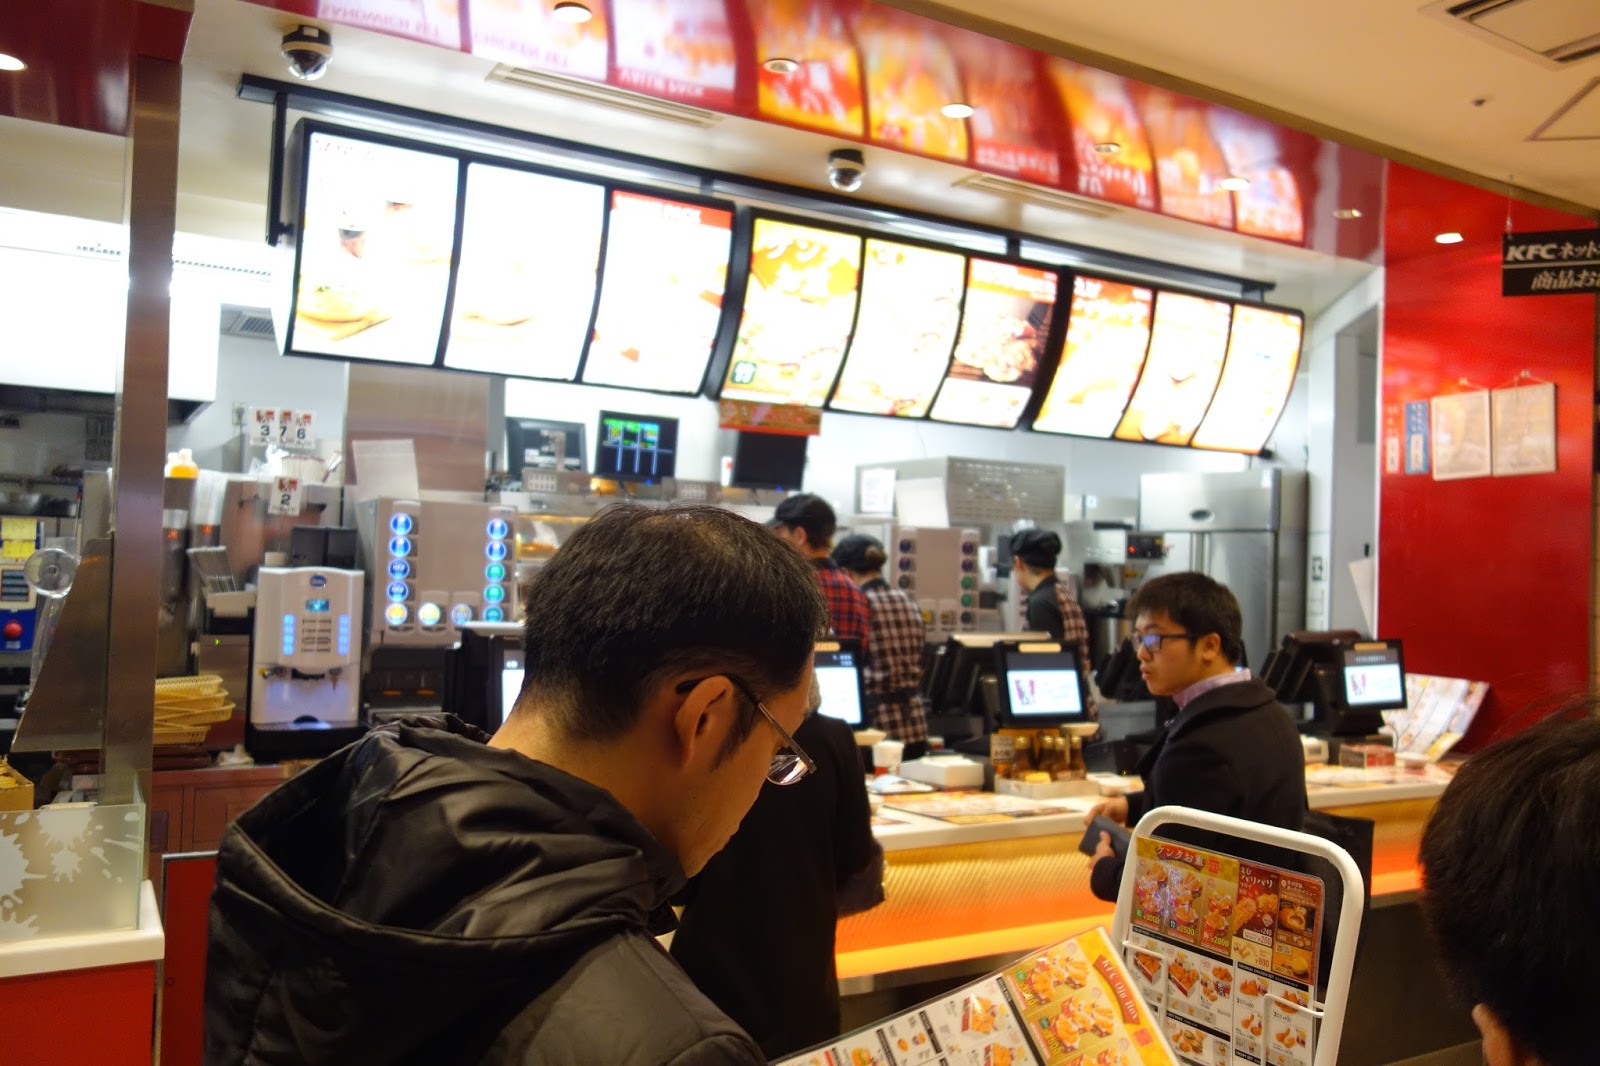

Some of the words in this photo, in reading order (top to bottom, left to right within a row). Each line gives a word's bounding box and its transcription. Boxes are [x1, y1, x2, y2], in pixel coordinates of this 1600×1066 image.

[1505, 243, 1557, 261] KFC
[1561, 240, 1600, 259] ネット
[1530, 268, 1600, 291] 商品お
[261, 424, 271, 437] 3
[279, 425, 288, 437] 7
[296, 427, 306, 440] 6
[280, 494, 292, 506] 2
[1177, 925, 1196, 936] ¥2500
[1211, 935, 1230, 948] ¥2000
